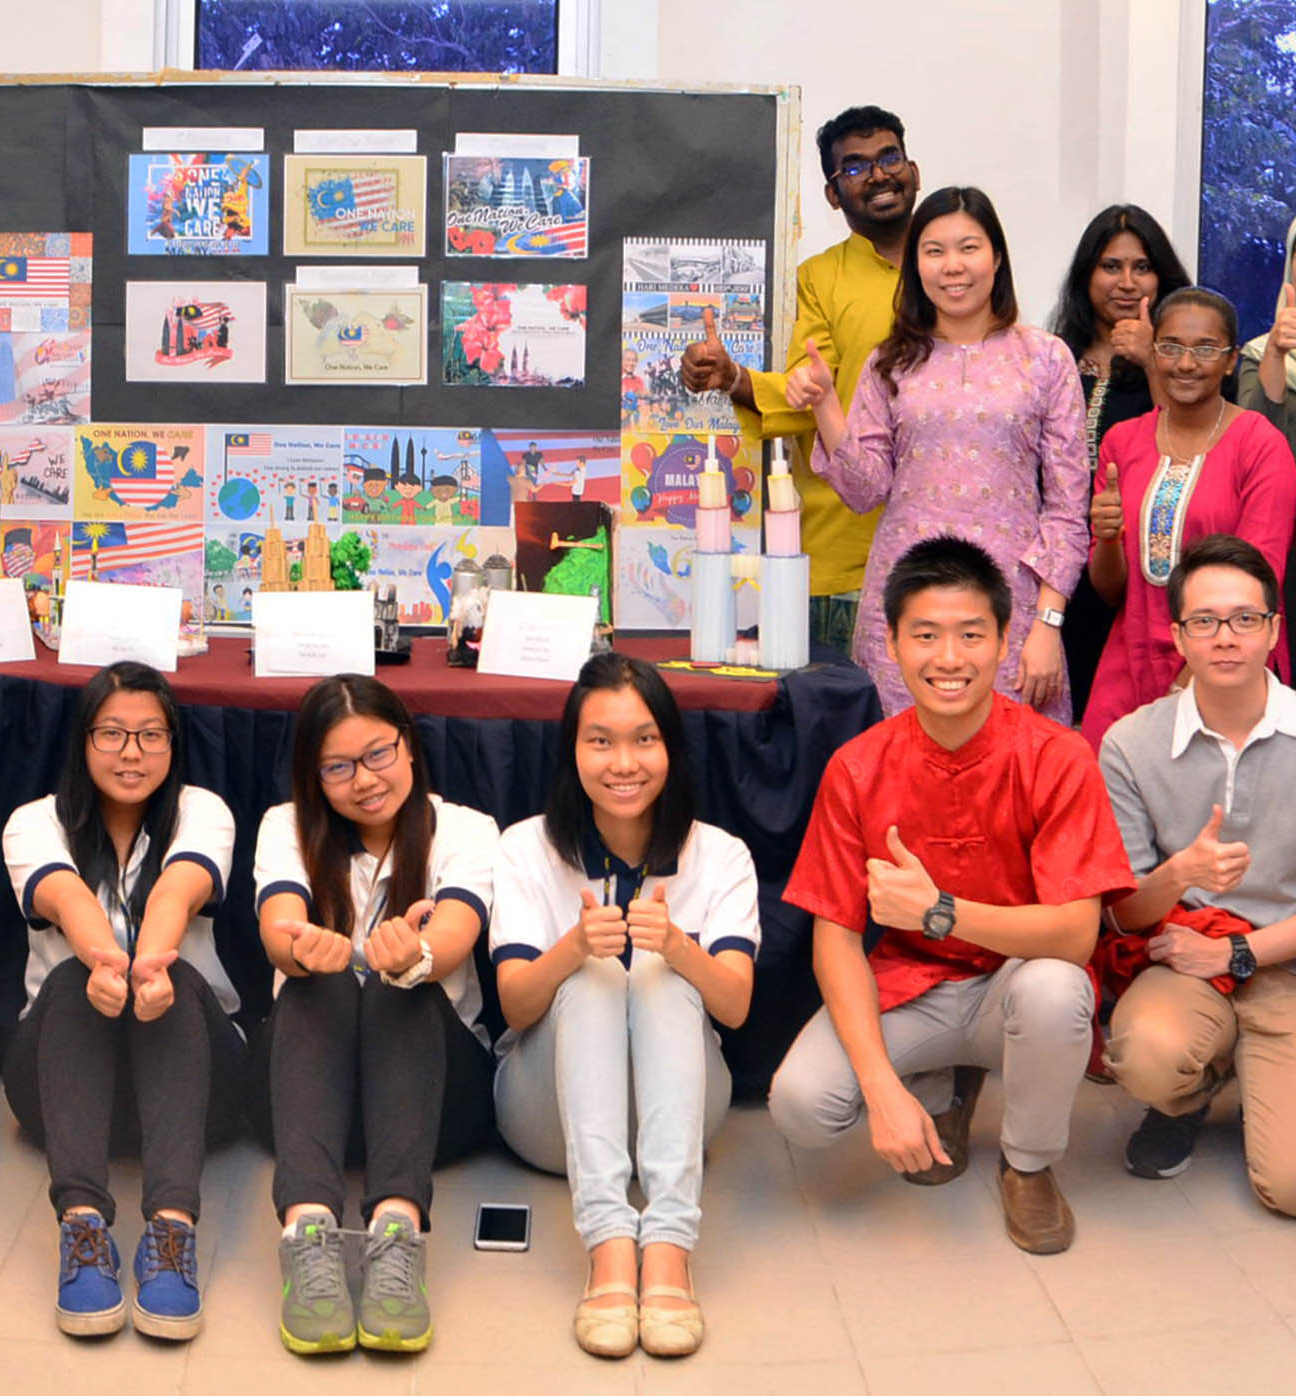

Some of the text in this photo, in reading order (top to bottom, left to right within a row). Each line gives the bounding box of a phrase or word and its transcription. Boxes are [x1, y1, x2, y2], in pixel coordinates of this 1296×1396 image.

[186, 167, 221, 186] ONE
[185, 199, 222, 221] WE
[335, 207, 364, 219] ONE
[184, 219, 222, 237] CARE
[381, 220, 415, 232] CARE
[500, 214, 562, 234] We Care
[93, 430, 111, 438] ONE
[151, 430, 164, 438] WE
[48, 455, 65, 466] WE
[43, 468, 68, 479] CARE
